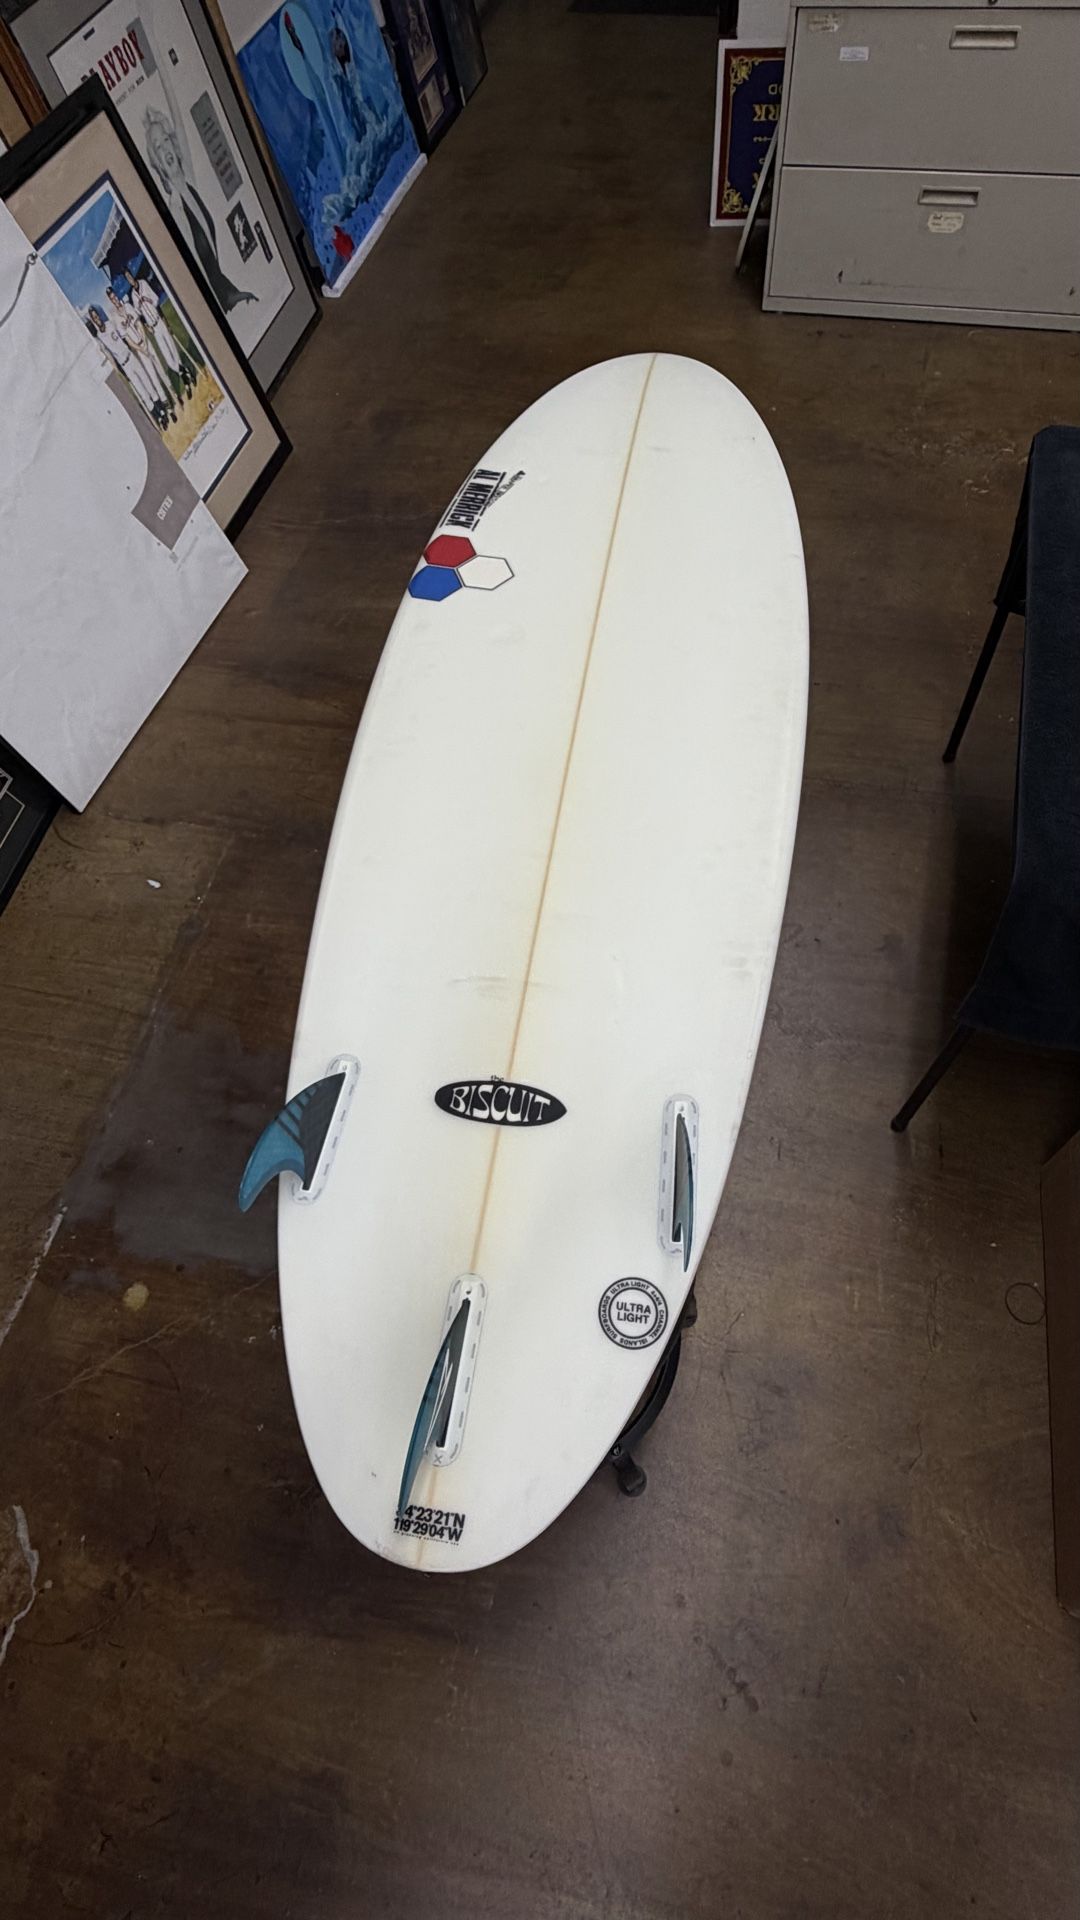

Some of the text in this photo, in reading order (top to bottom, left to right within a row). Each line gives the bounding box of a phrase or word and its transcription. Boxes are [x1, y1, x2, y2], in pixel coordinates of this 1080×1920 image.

[81, 29, 144, 91] AYBOY
[445, 468, 501, 529] AL MERRICK
[450, 1084, 551, 1123] BISCUIT
[610, 1281, 629, 1295] ULTRA
[630, 1281, 650, 1290] LIGHT
[616, 1301, 651, 1314] ULTRA
[617, 1311, 650, 1324] LIGHT
